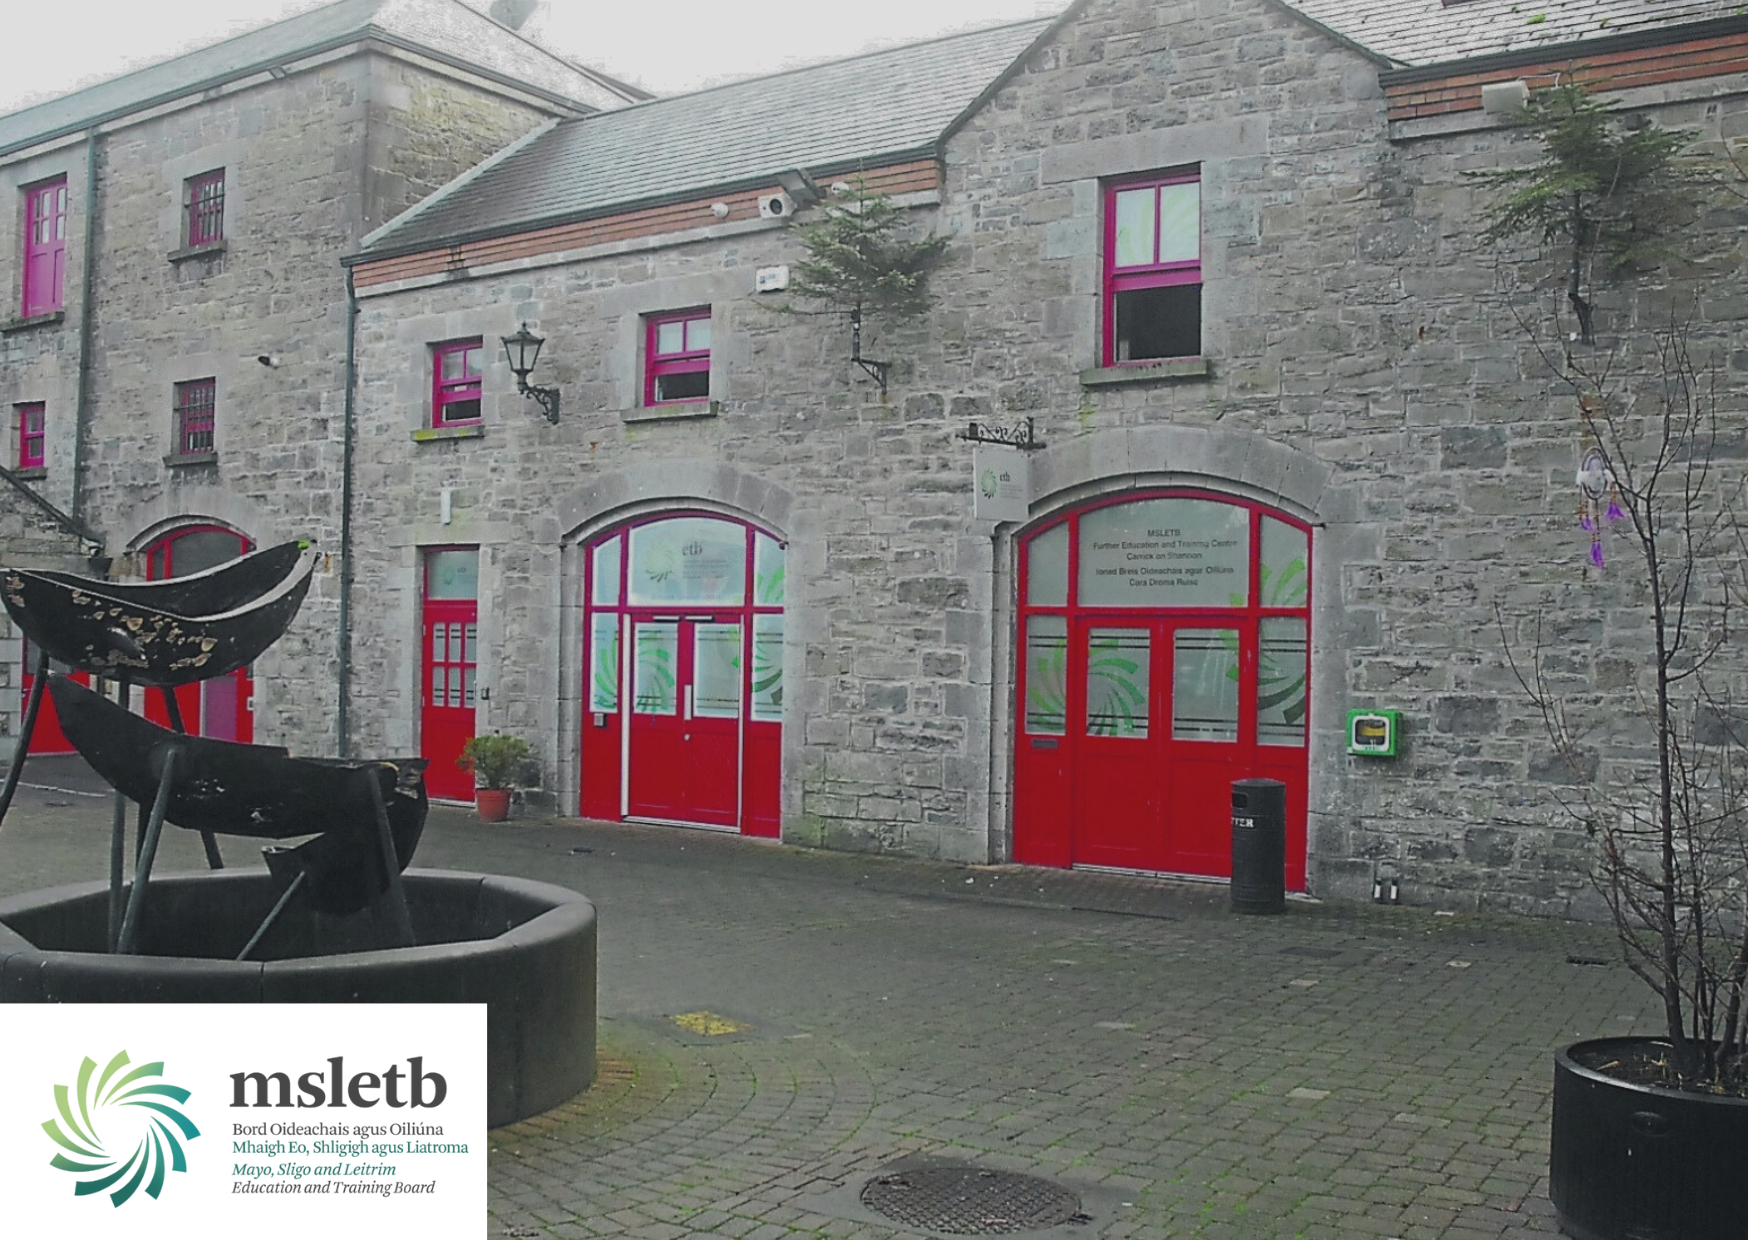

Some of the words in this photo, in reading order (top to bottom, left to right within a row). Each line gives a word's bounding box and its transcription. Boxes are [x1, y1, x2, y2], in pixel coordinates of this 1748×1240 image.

[1147, 529, 1181, 537] MSLETB
[1093, 542, 1120, 550] Further
[1121, 541, 1159, 549] Education
[1177, 540, 1210, 548] Training
[1211, 539, 1238, 547] Centre
[1126, 552, 1154, 561] Carrick
[1168, 552, 1203, 560] Shannon
[1129, 578, 1148, 586] Cara
[1149, 578, 1175, 586] Droma
